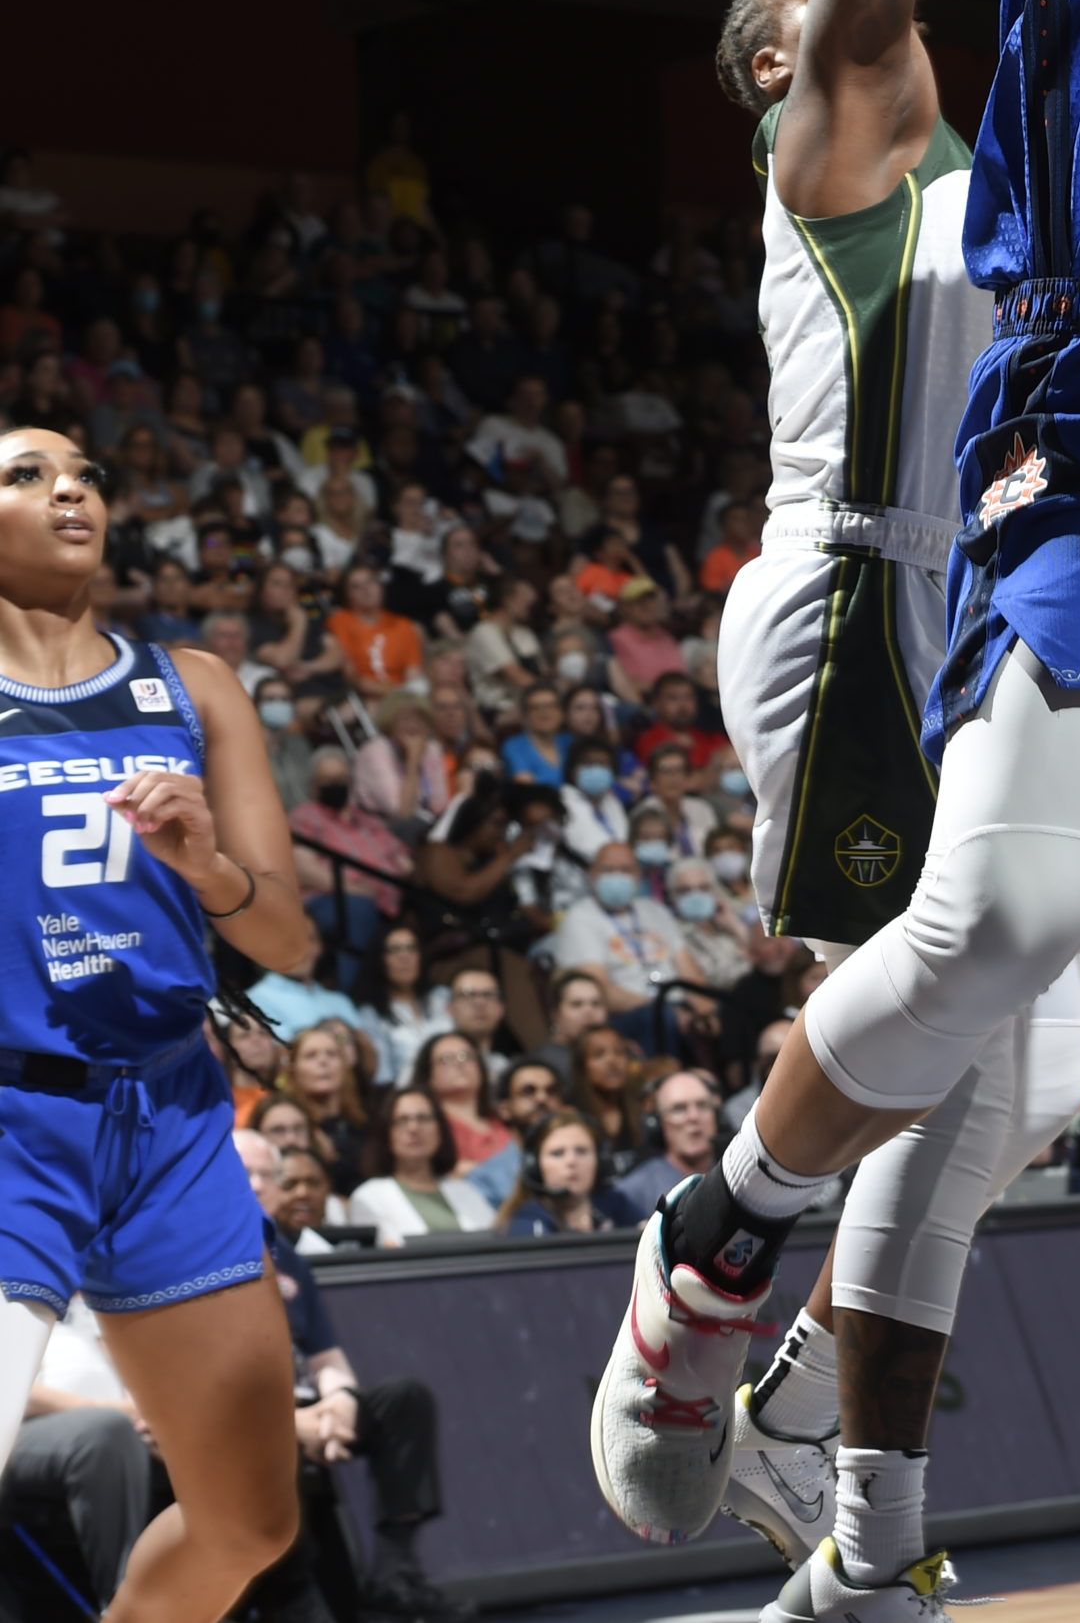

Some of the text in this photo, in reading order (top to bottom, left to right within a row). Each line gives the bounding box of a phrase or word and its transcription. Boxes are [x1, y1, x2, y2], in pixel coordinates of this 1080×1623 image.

[41, 791, 133, 888] 21
[36, 912, 79, 935] Yale
[41, 930, 142, 959] NewHaven
[47, 953, 114, 983] Health
